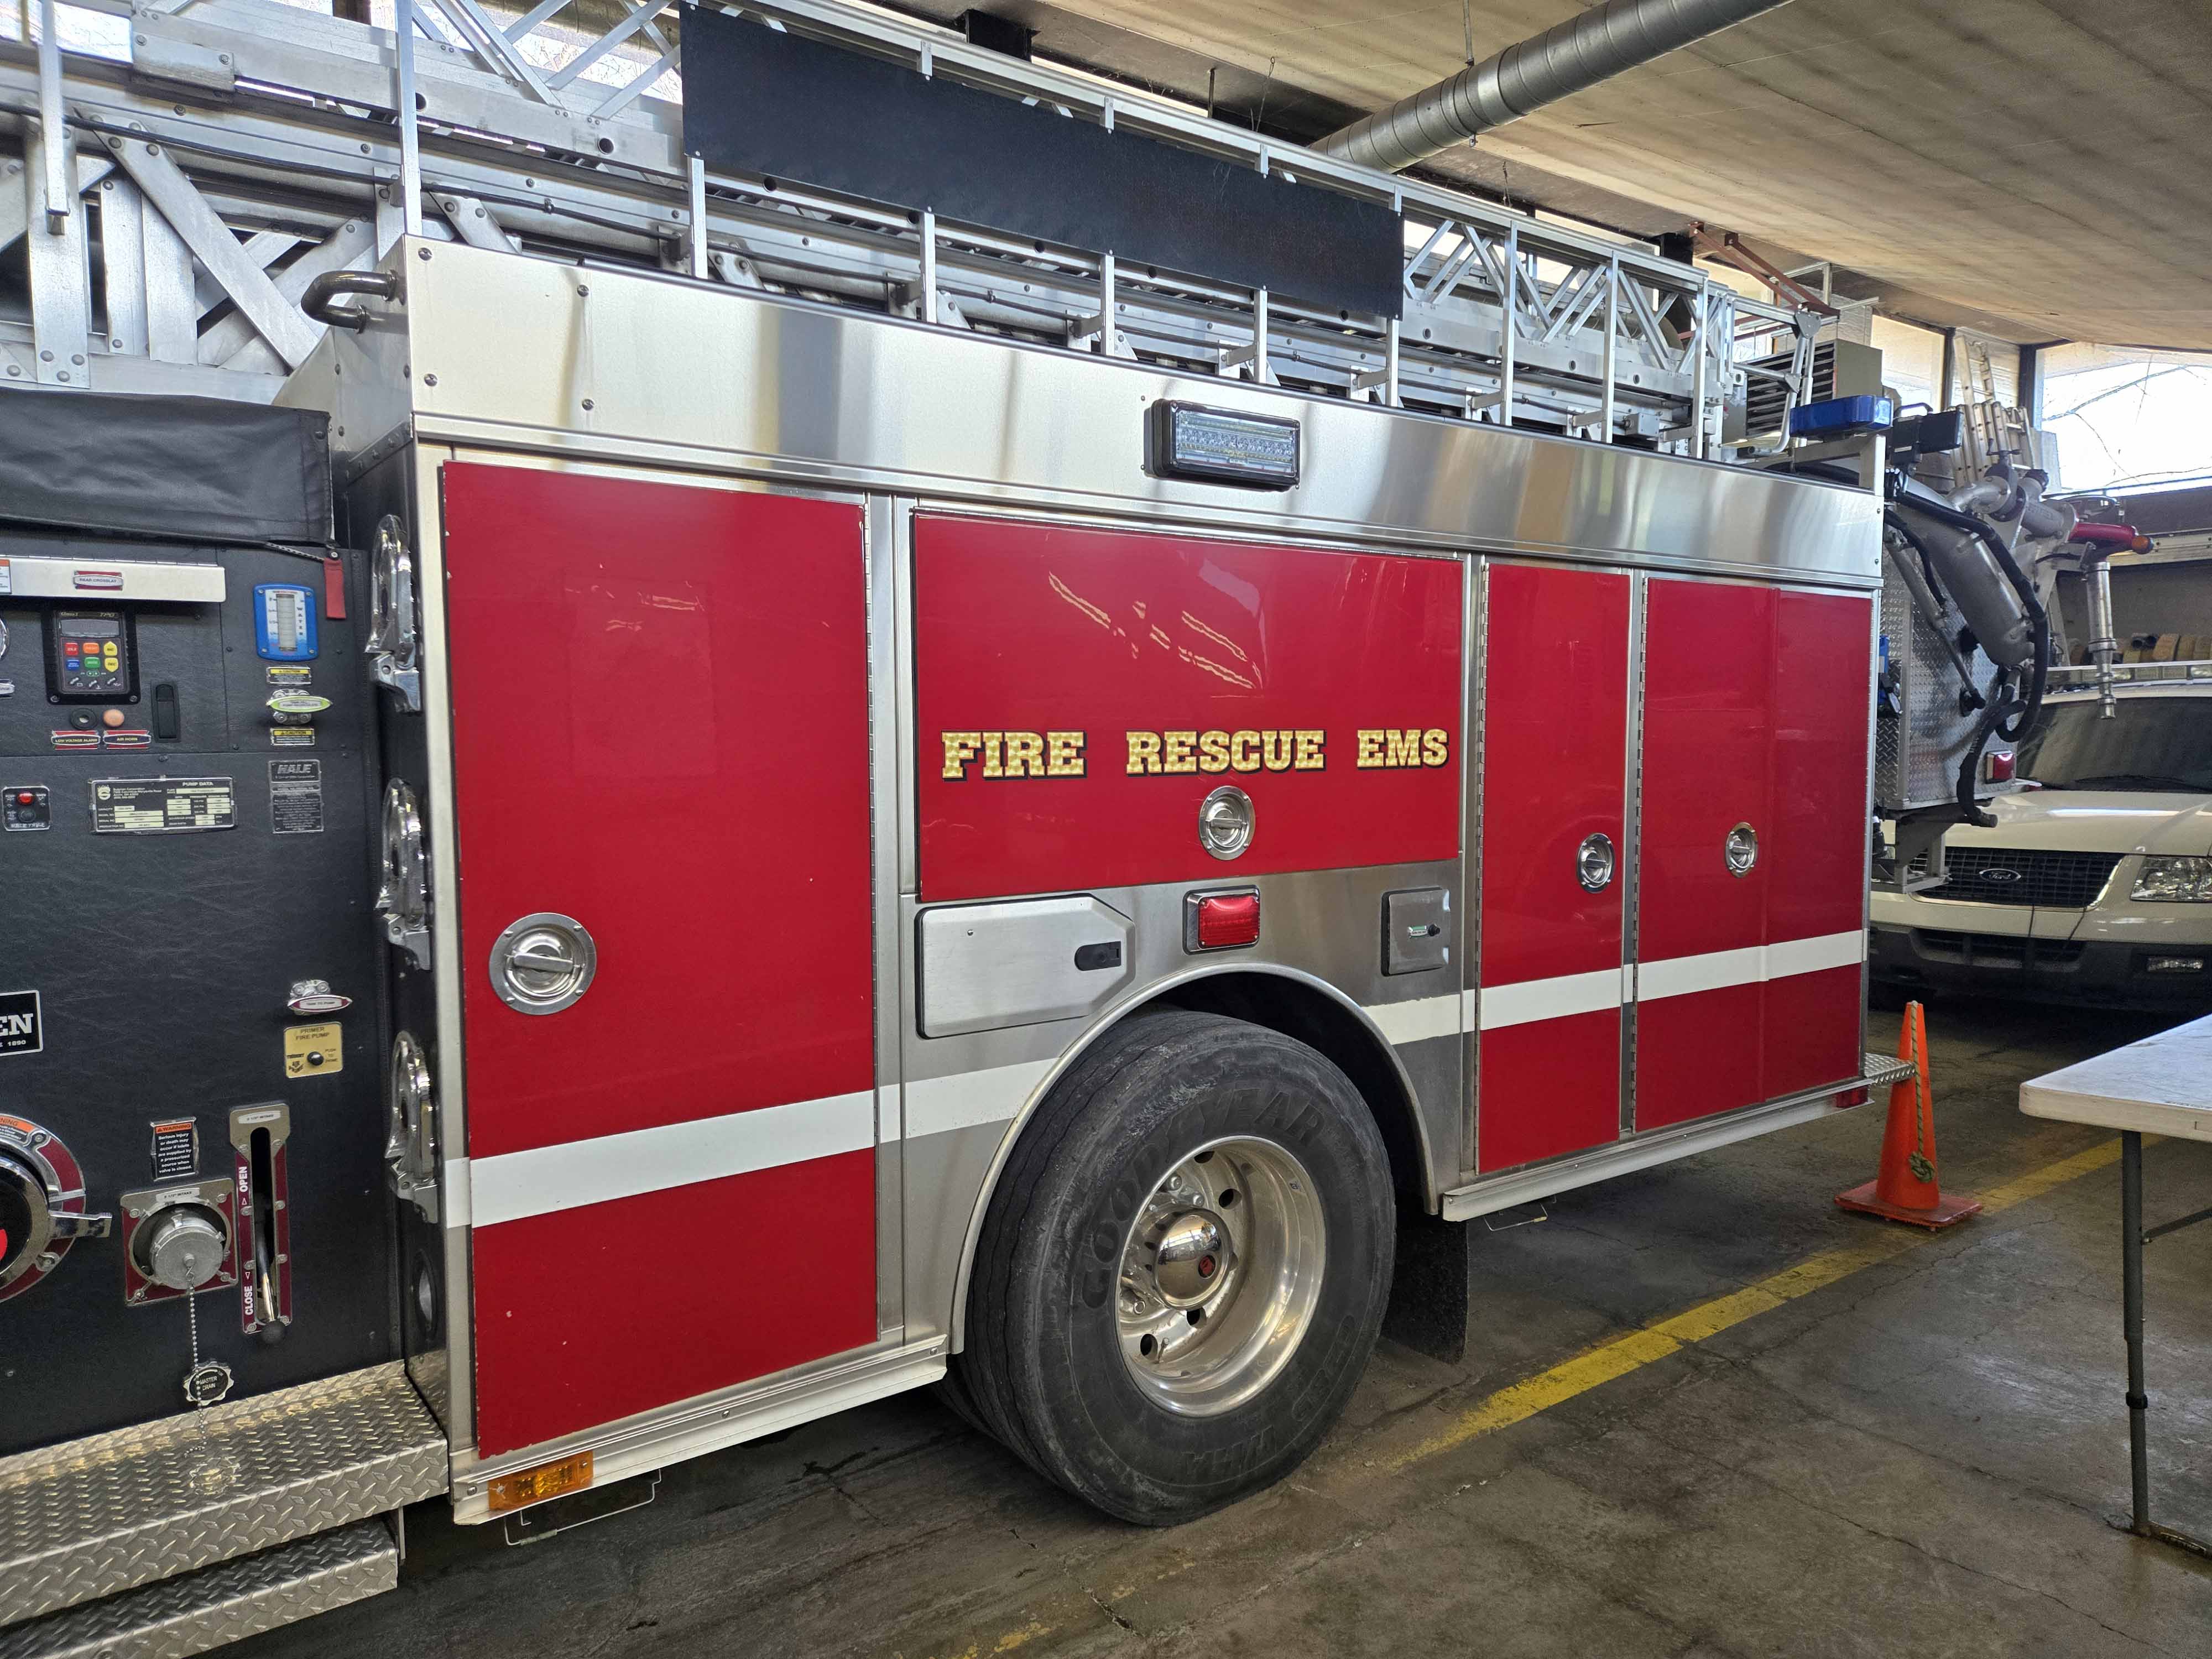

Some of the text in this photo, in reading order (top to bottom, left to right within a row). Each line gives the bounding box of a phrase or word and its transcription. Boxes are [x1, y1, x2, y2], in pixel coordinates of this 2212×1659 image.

[941, 727, 1450, 781] FIRE RESCUE EMS
[278, 764, 313, 774] HALE
[164, 1154, 190, 1162] pressurized
[238, 1166, 248, 1193] OPEN
[244, 1285, 254, 1316] CLOSE
[200, 1376, 218, 1385] MASTER
[202, 1383, 216, 1391] DRAIN
